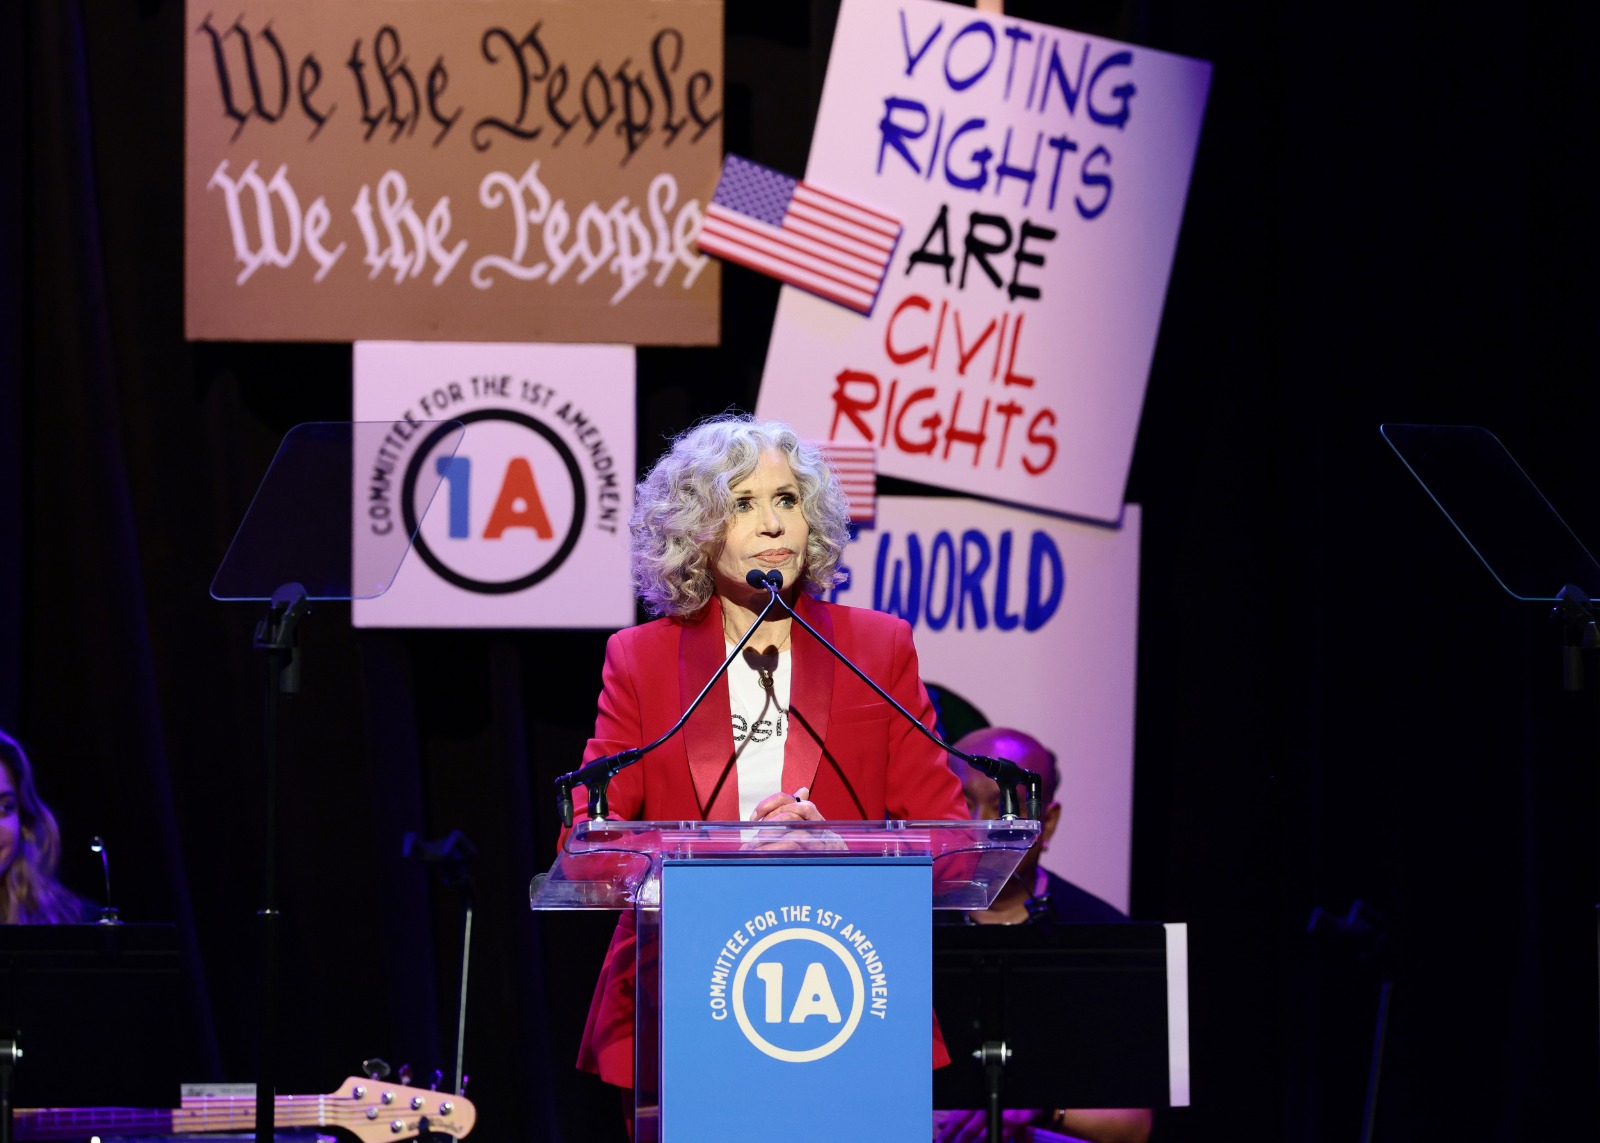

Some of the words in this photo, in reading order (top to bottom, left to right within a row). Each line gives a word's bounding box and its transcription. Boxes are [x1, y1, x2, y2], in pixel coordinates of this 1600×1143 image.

[197, 13, 336, 144] We
[346, 24, 464, 149] the
[471, 20, 723, 166] People
[899, 9, 1137, 131] VOTING
[876, 96, 1114, 221] RIGHTS
[207, 159, 347, 286] We
[352, 170, 468, 286] the
[470, 159, 709, 306] People
[904, 204, 1057, 301] ARE
[884, 293, 1035, 388] CIVIL
[368, 409, 423, 536] COMMITTEE
[419, 381, 464, 417] FOR
[470, 375, 513, 399] THE
[520, 380, 556, 407] 1ST
[555, 400, 621, 536] AMENDMENT
[829, 368, 1059, 476] RIGHTS
[435, 456, 554, 541] 1A
[873, 528, 1065, 633] WORLD
[732, 709, 788, 742] esi
[710, 930, 750, 1020] COMMITTEE
[745, 910, 778, 937] FOR
[780, 905, 811, 922] THE
[816, 908, 843, 930] 1ST
[839, 923, 888, 1020] AMENDMENT
[756, 962, 842, 1023] 1A
